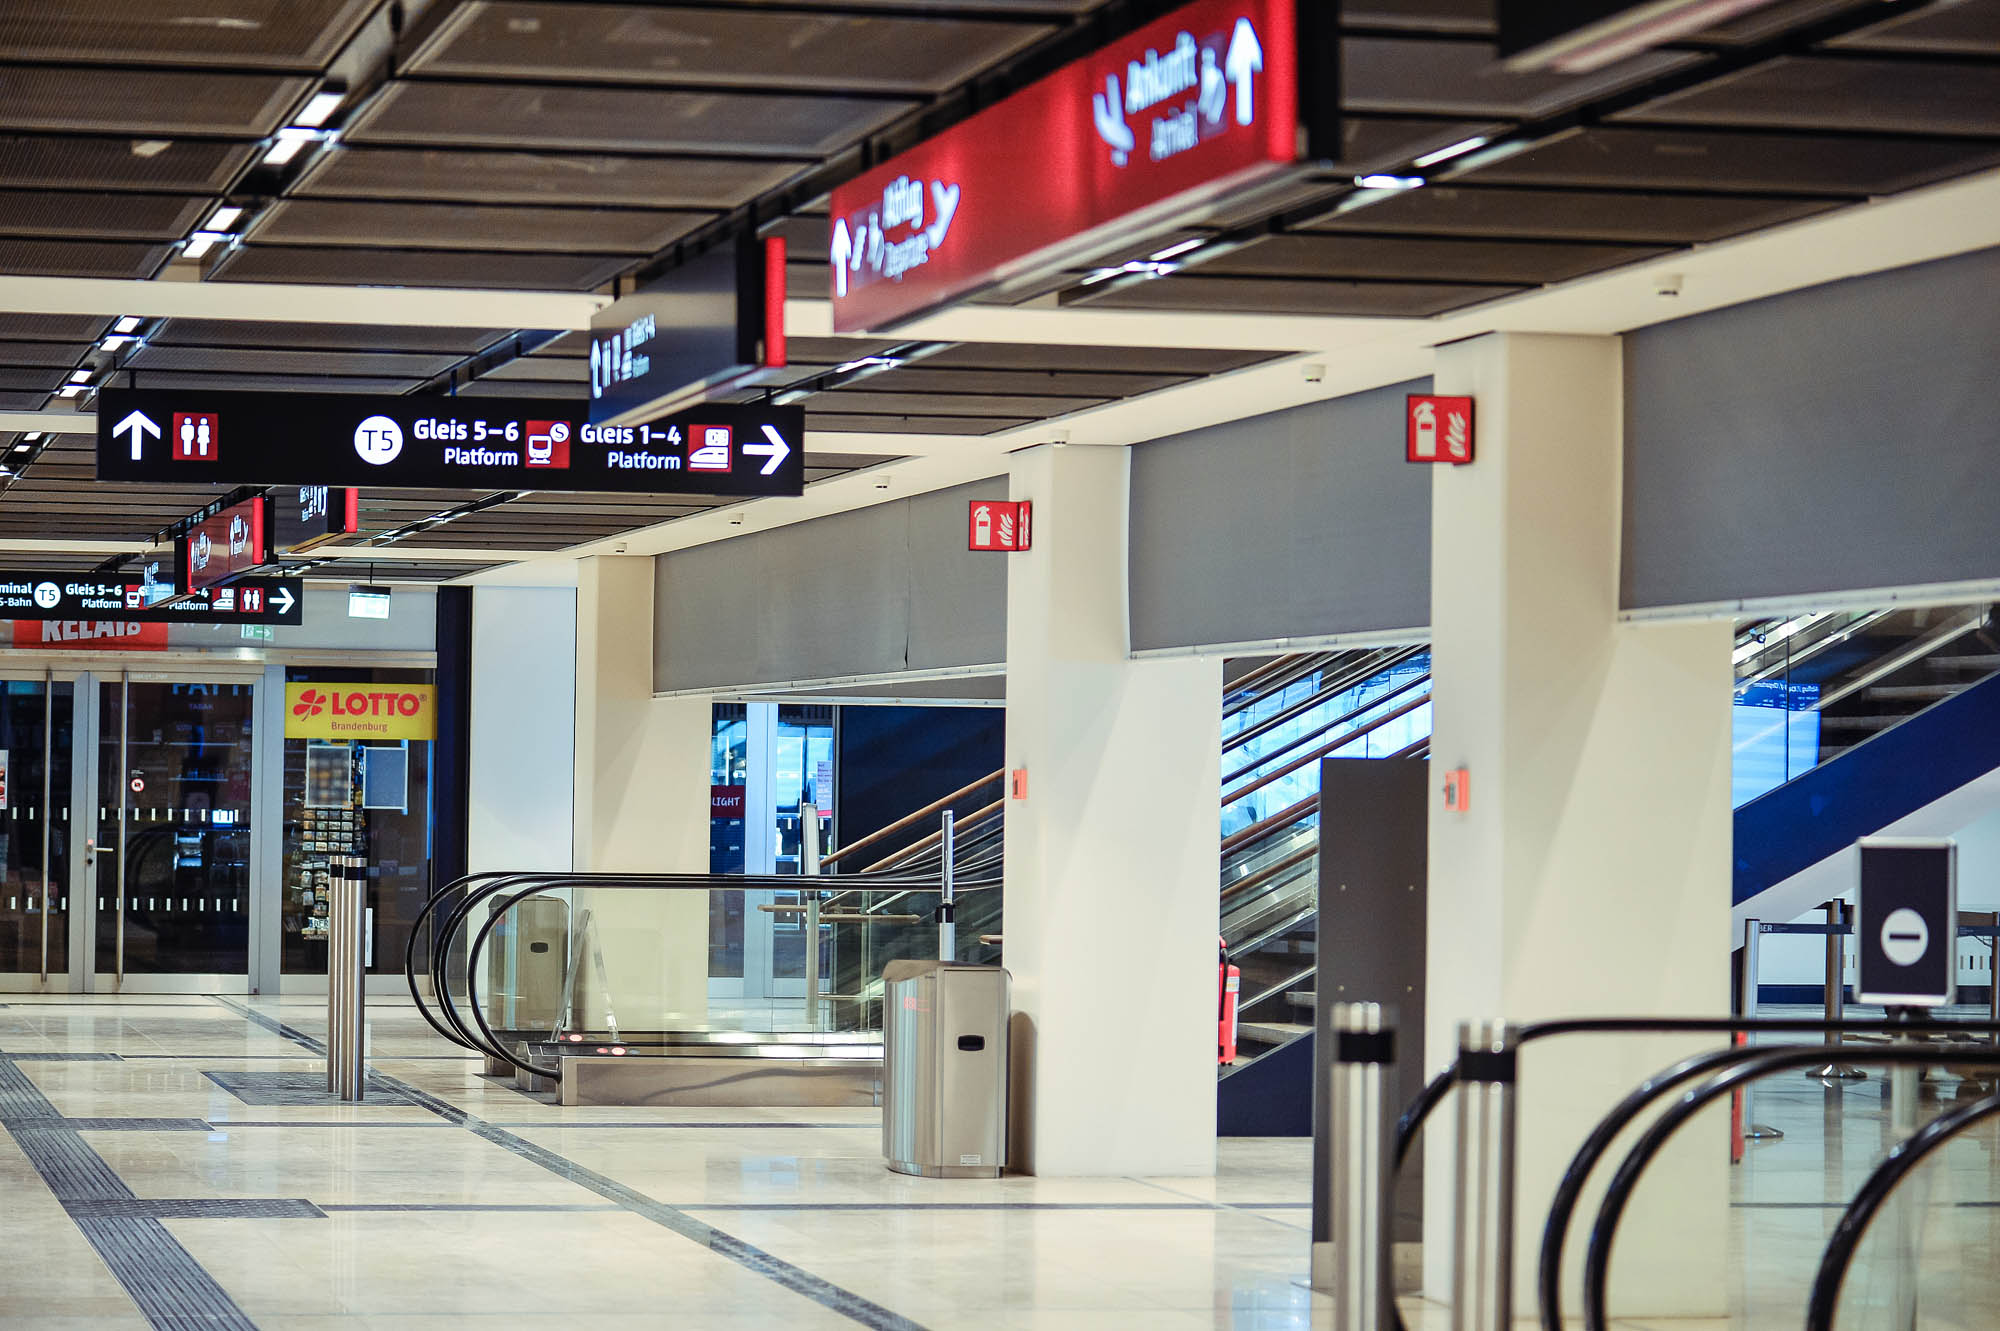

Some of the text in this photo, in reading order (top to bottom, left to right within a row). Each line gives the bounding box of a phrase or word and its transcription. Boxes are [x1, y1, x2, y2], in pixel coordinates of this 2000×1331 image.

[413, 418, 468, 440] Gleis
[580, 423, 634, 444] Gleis
[362, 429, 394, 451] T5
[444, 447, 519, 466] Platform
[607, 450, 681, 470] Platform
[39, 589, 56, 601] T5
[65, 583, 94, 596] Gleis
[81, 599, 122, 609] Platform
[331, 692, 420, 717] LOTTO
[331, 721, 388, 733] Brandenburg
